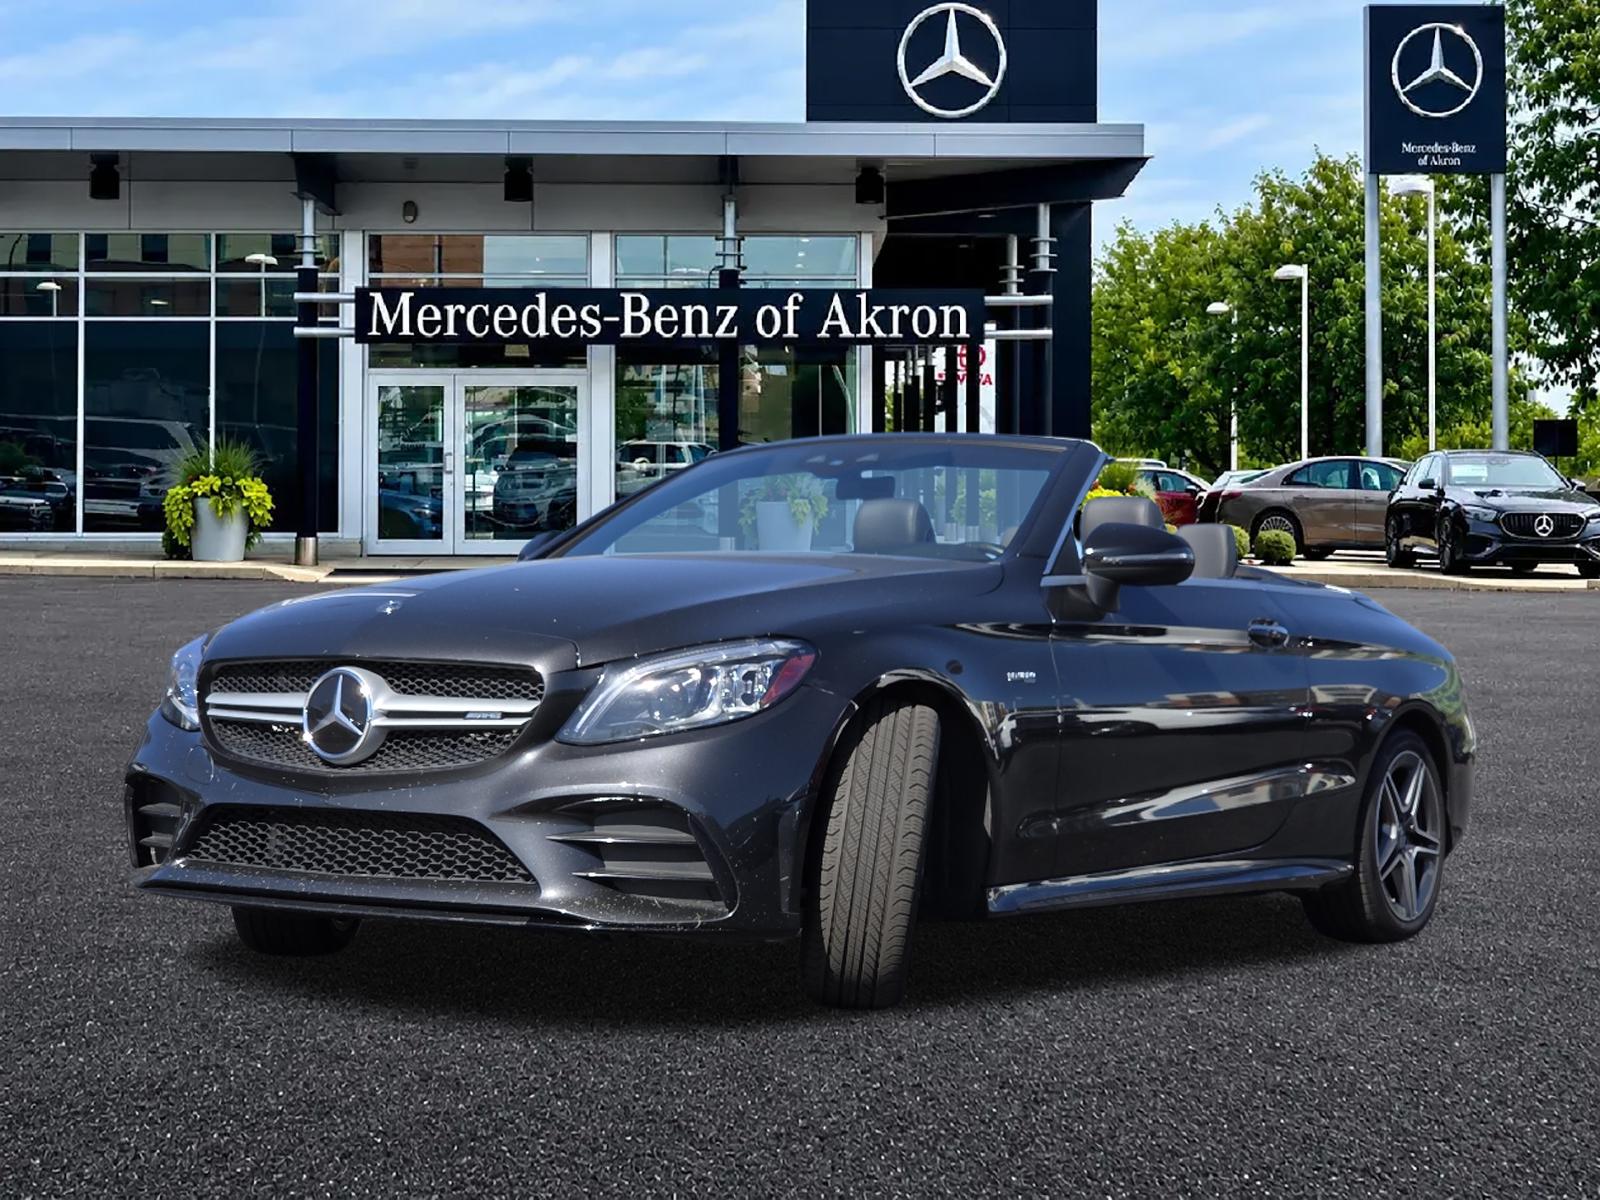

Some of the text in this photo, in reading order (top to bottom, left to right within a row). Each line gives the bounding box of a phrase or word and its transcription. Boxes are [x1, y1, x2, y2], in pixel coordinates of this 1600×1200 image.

[1401, 141, 1477, 153] Mercedes-Benz
[1417, 154, 1461, 166] of Akron
[367, 291, 971, 339] Mercedes-Benz of Akron
